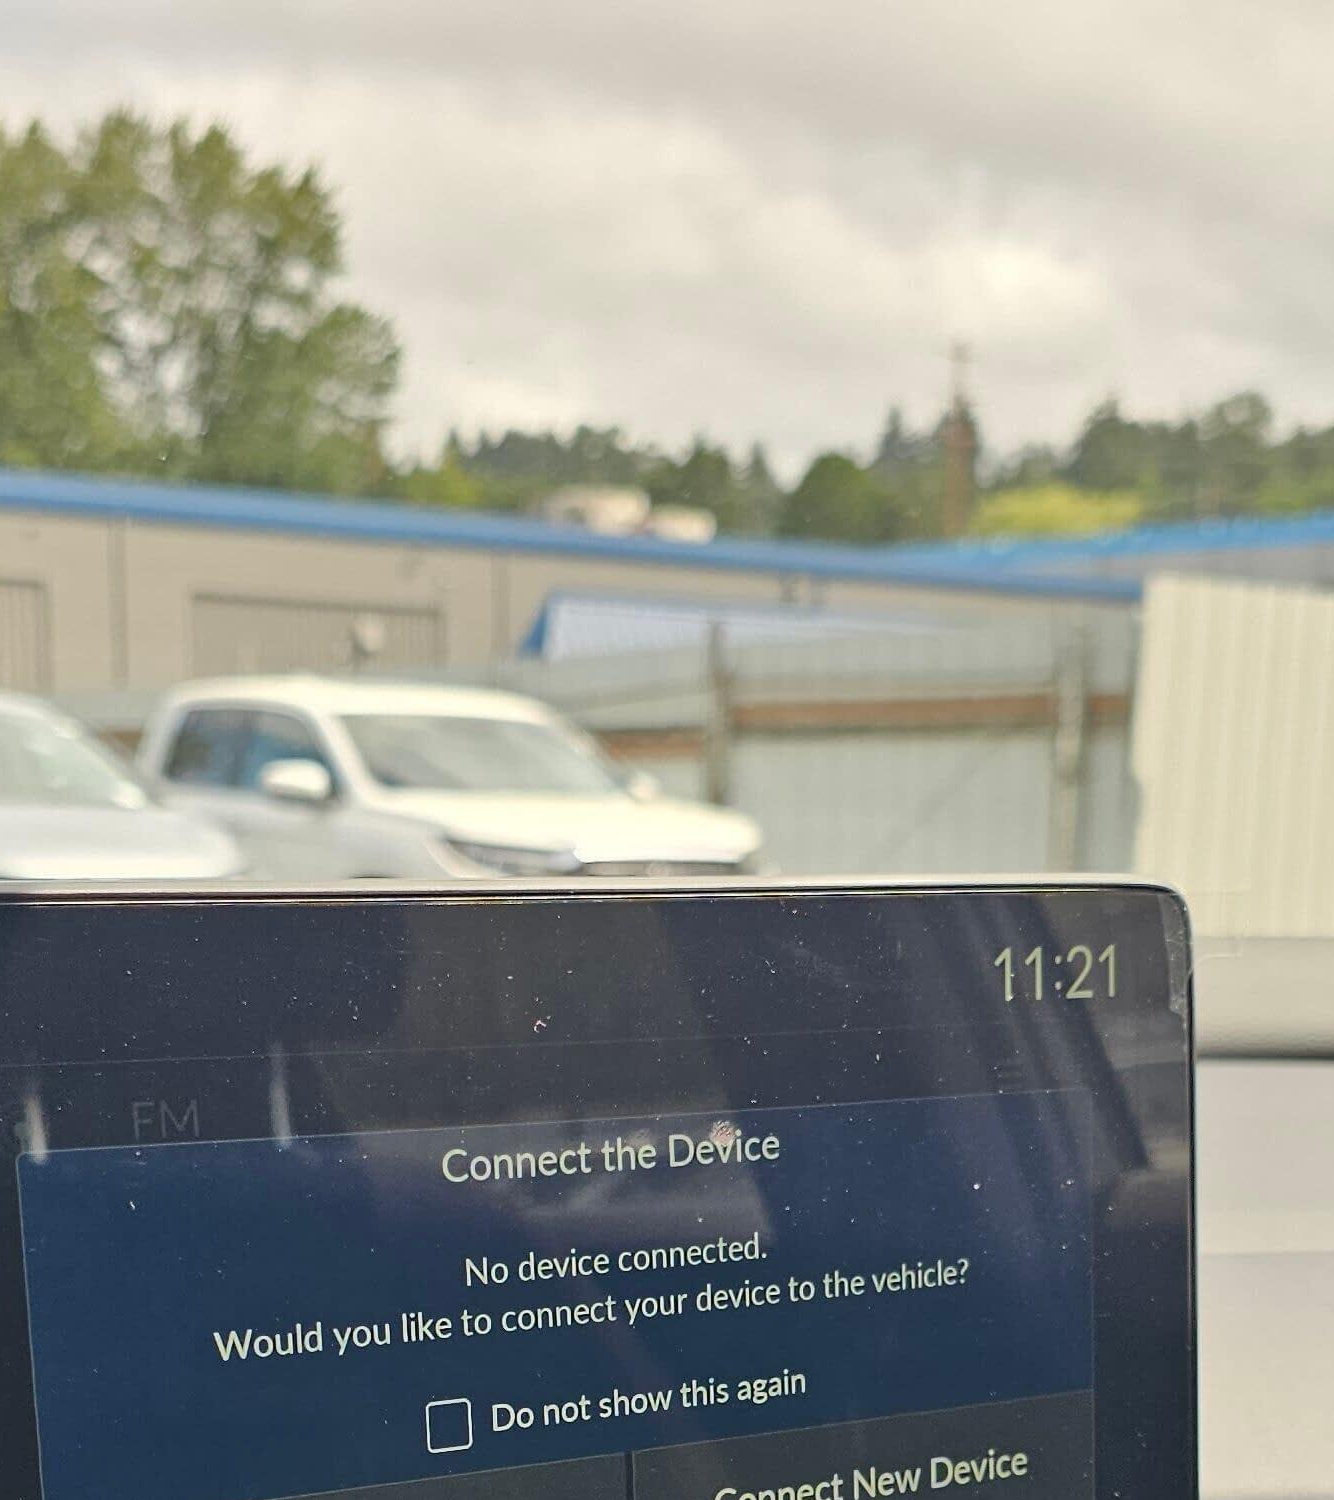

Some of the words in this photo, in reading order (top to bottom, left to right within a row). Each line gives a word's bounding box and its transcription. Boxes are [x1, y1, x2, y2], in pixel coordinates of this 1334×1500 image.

[993, 944, 1118, 1001] 11:21
[132, 1100, 200, 1141] FM
[441, 1140, 592, 1183] Connect
[602, 1138, 658, 1172] the
[668, 1129, 781, 1168] Device
[464, 1257, 509, 1286] No
[518, 1248, 610, 1282] device
[617, 1232, 768, 1276] connected.
[213, 1321, 323, 1362] Would
[331, 1322, 392, 1356] you
[401, 1310, 453, 1344] like
[460, 1310, 493, 1337] to
[500, 1293, 617, 1332] connect
[623, 1292, 688, 1329] your
[695, 1280, 782, 1312] device
[788, 1276, 817, 1303] to
[822, 1268, 867, 1300] the
[871, 1256, 970, 1294] vehicle?
[491, 1402, 535, 1433] Do
[543, 1393, 592, 1426] not
[598, 1386, 673, 1420] show
[679, 1377, 729, 1409] this
[736, 1369, 808, 1405] again
[852, 1463, 922, 1500] New
[929, 1449, 1029, 1490] Device
